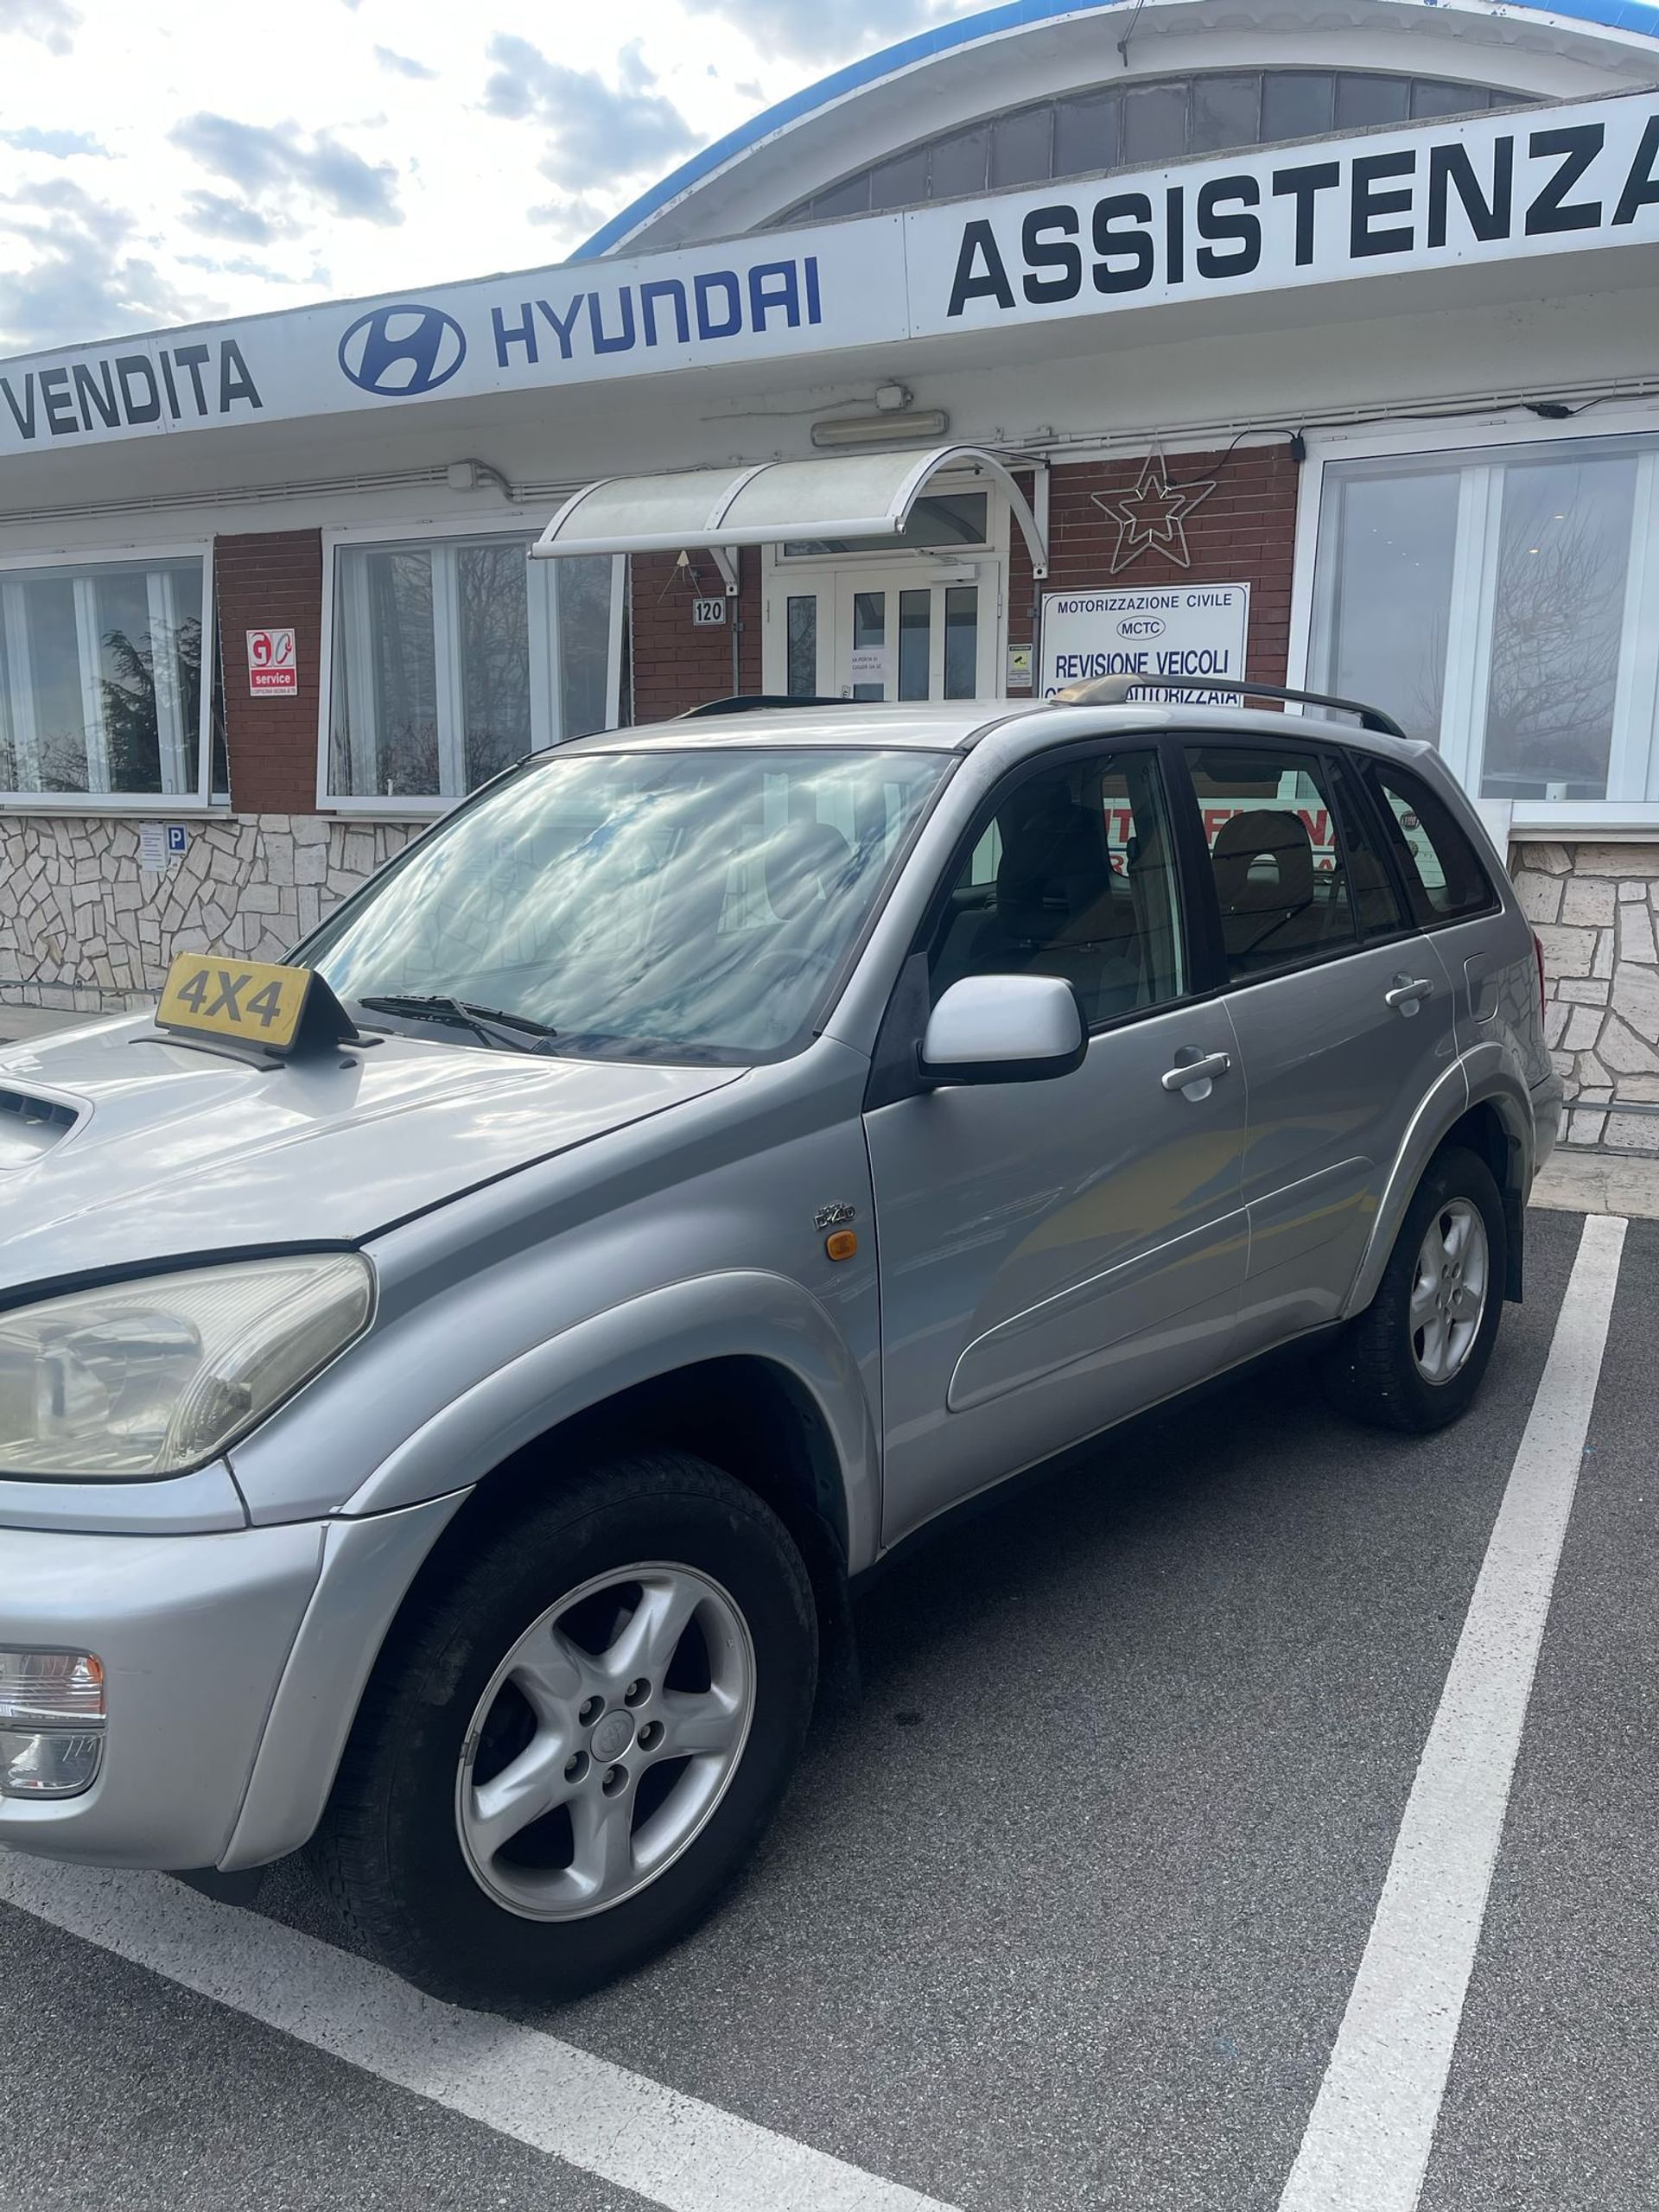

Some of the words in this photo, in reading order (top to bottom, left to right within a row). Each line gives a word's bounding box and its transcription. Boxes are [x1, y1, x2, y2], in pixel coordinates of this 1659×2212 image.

[947, 114, 1659, 317] ASSISTENZA
[491, 257, 822, 367] HYUNDAI
[0, 339, 263, 440] VENDITA
[696, 601, 721, 621] 120
[1058, 596, 1179, 613] MOTORIZZAZIONE
[1186, 594, 1232, 607] CIVILE
[1122, 621, 1160, 634] MCTC
[1056, 652, 1149, 678] REVISIONE
[1157, 650, 1229, 675] VEICOLI
[256, 672, 290, 684] service
[171, 830, 181, 848] P
[176, 969, 283, 1027] 4X4
